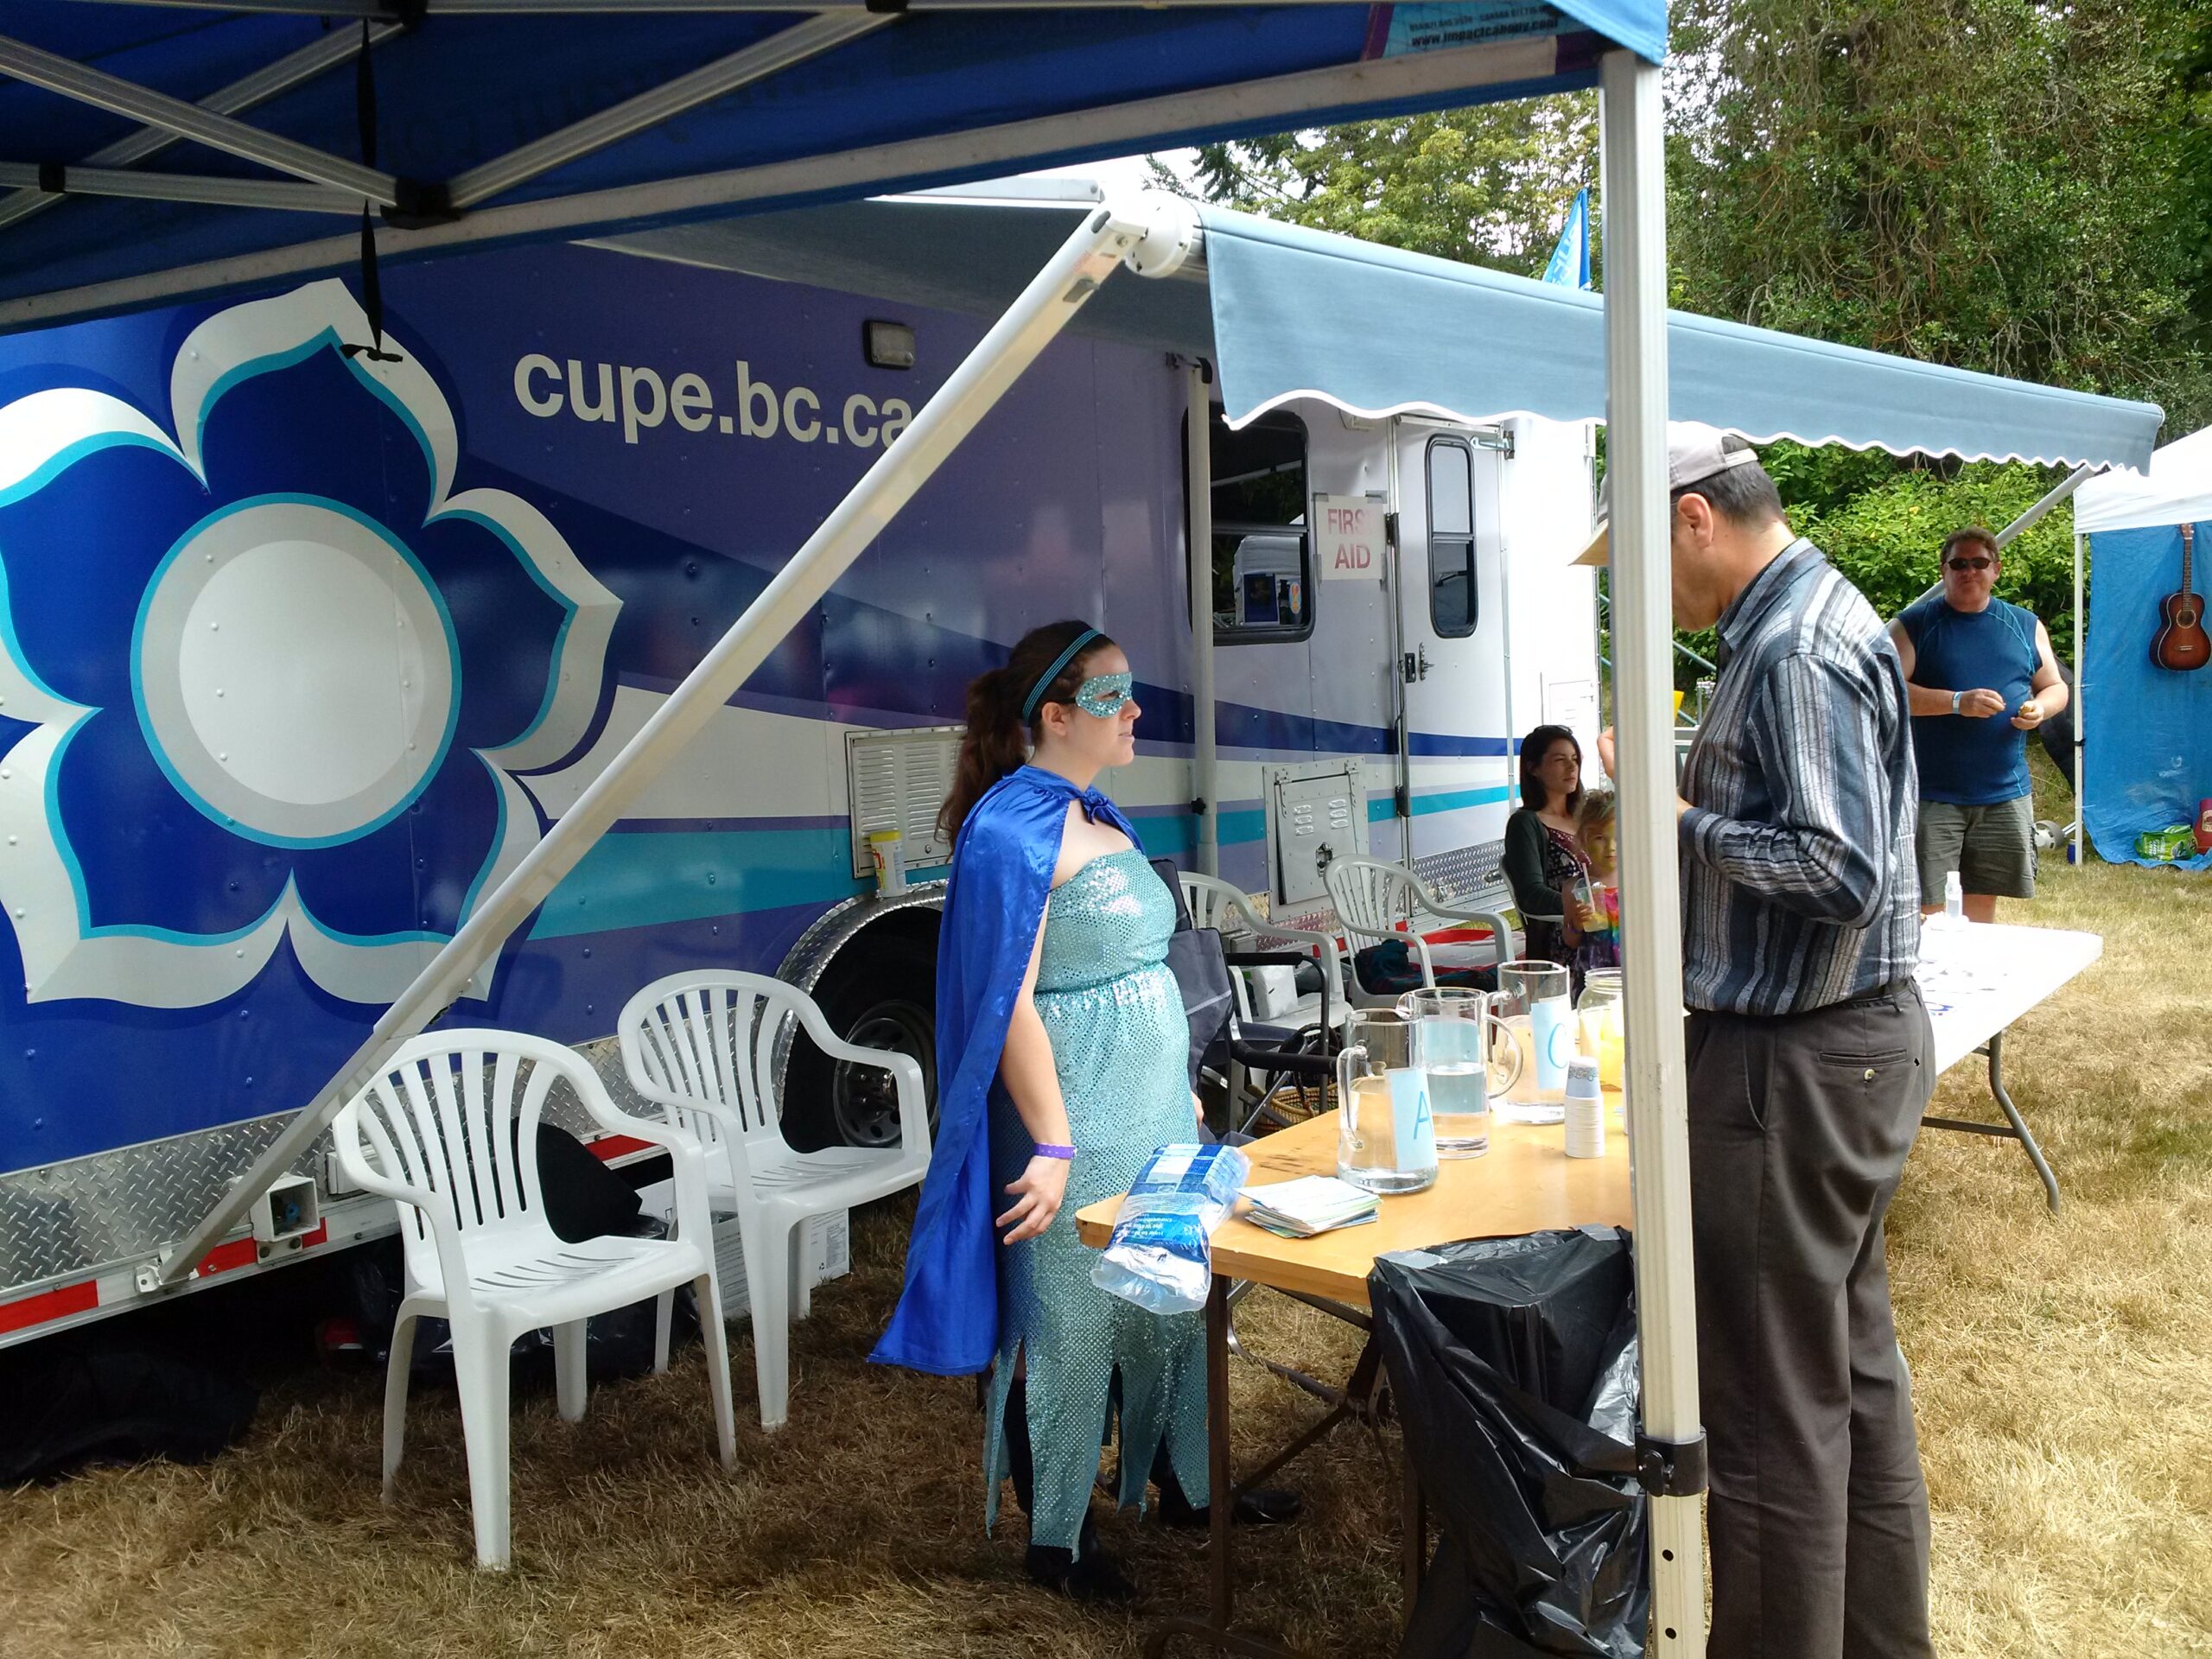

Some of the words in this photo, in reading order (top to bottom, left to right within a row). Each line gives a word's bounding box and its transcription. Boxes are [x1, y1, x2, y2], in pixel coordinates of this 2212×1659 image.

[514, 353, 912, 448] cupe.bc.ca
[1327, 508, 1375, 535] FIRS
[1334, 543, 1371, 569] AID
[1414, 1090, 1433, 1140] A
